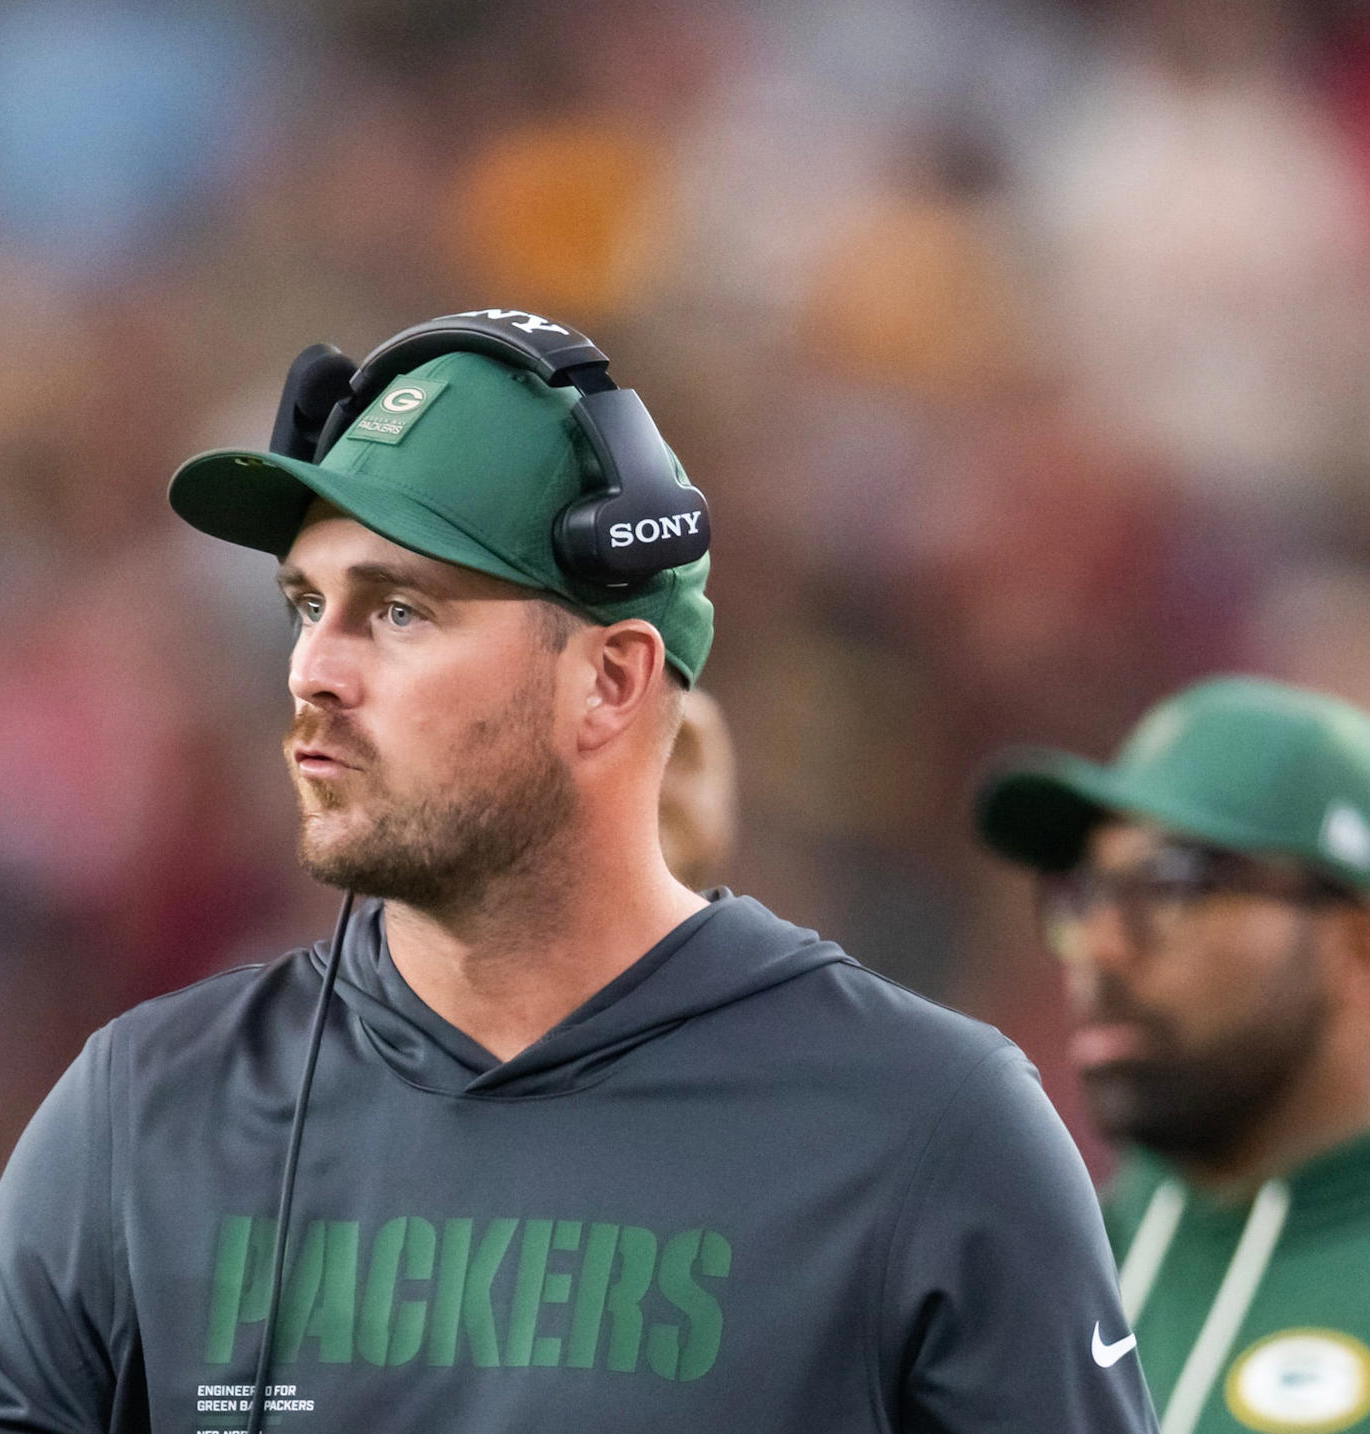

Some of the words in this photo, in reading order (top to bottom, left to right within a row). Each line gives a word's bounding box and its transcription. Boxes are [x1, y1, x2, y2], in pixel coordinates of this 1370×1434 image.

[383, 387, 424, 412] G
[609, 511, 701, 547] SONY
[204, 1215, 732, 1382] PACKERS
[273, 1385, 297, 1396] FOR
[196, 1400, 237, 1411] GREEN
[263, 1400, 315, 1411] PACKERS
